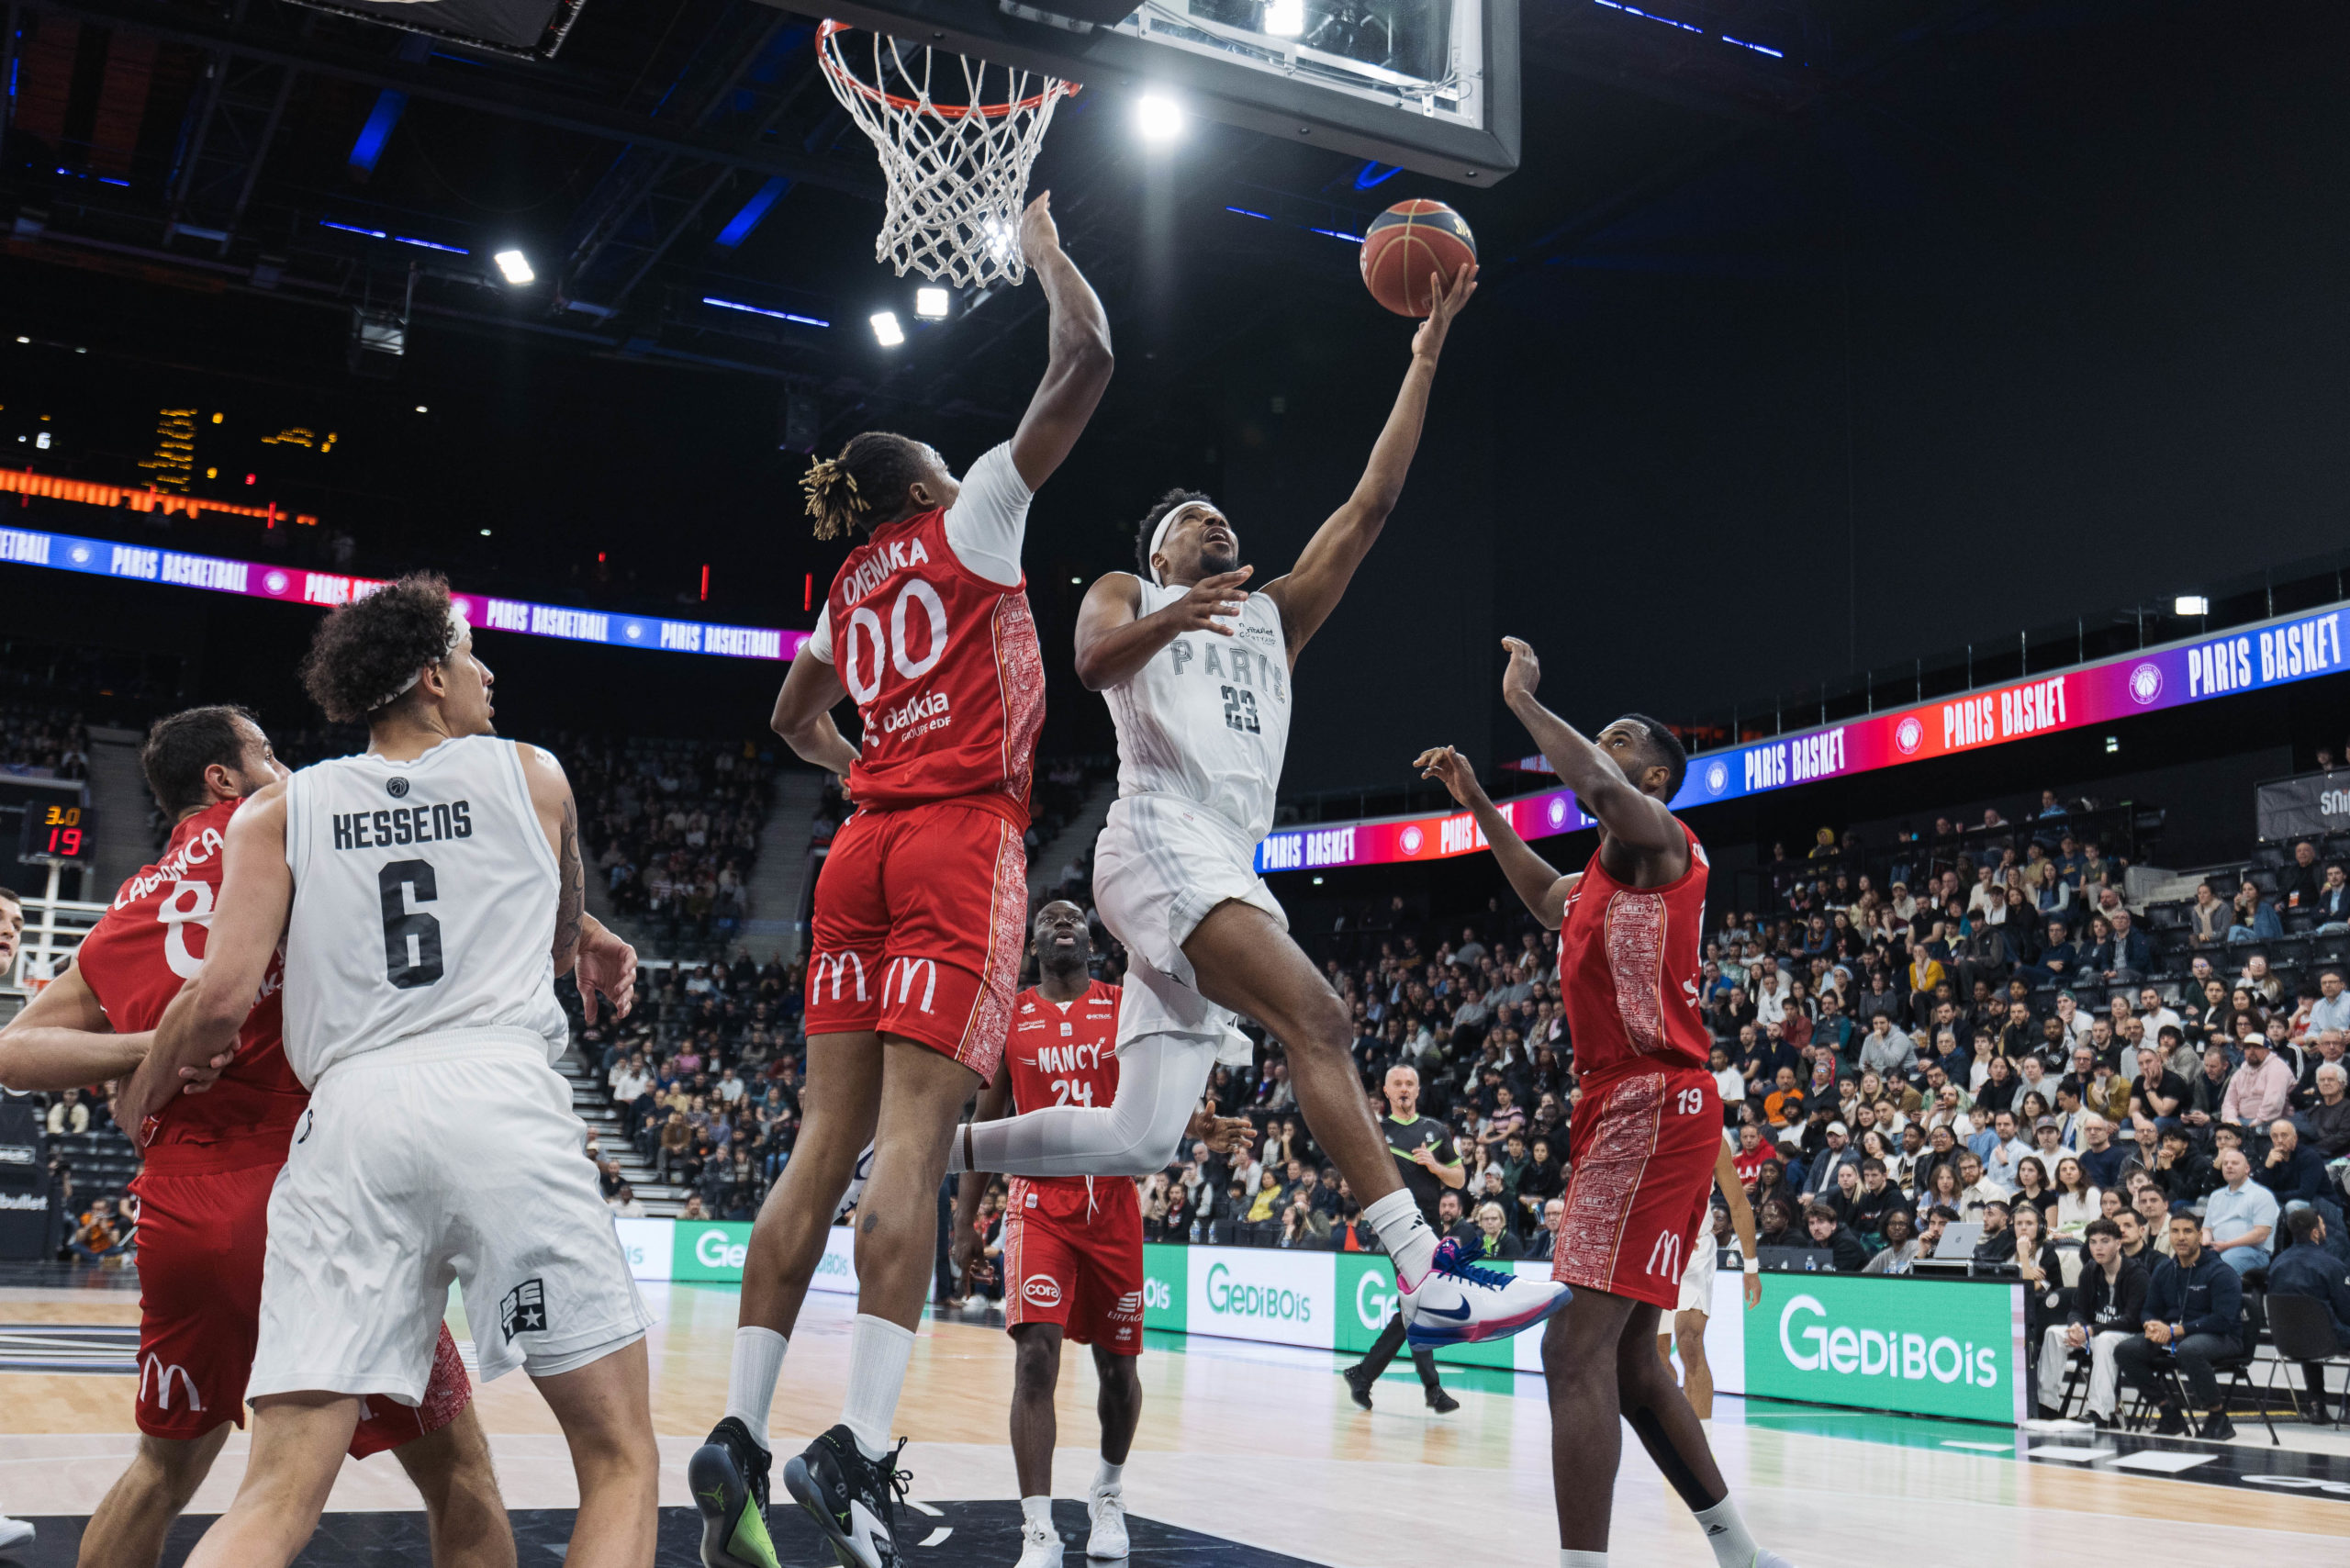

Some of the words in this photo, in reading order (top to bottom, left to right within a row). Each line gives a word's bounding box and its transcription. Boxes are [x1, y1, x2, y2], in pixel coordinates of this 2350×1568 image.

[111, 545, 158, 579] PARIS
[162, 553, 248, 592] BASKETBALL
[304, 573, 350, 605] PARIS
[487, 599, 529, 632] PARIS
[532, 606, 609, 642] BASKETBALL
[660, 622, 702, 652] PARIS
[704, 626, 780, 658] BASKETBALL
[846, 579, 949, 706] 00
[2188, 637, 2251, 698] PARIS
[2259, 613, 2342, 682] BASKET
[1221, 685, 1260, 734] 23
[1943, 697, 1994, 749] PARIS
[2001, 676, 2066, 737] BASKET
[1745, 745, 1786, 792] PARIS
[1793, 727, 1845, 783] BASKET
[45, 805, 81, 826] 3.0
[1440, 814, 1473, 855] PARIS
[48, 827, 83, 856] 19
[1262, 833, 1302, 870] PARIS
[1306, 827, 1356, 866] BASKET
[377, 858, 444, 990] 6
[1037, 1041, 1102, 1074] NANCY
[1050, 1078, 1093, 1108] 24
[1676, 1087, 1704, 1115] 19
[1024, 1282, 1060, 1299] cora
